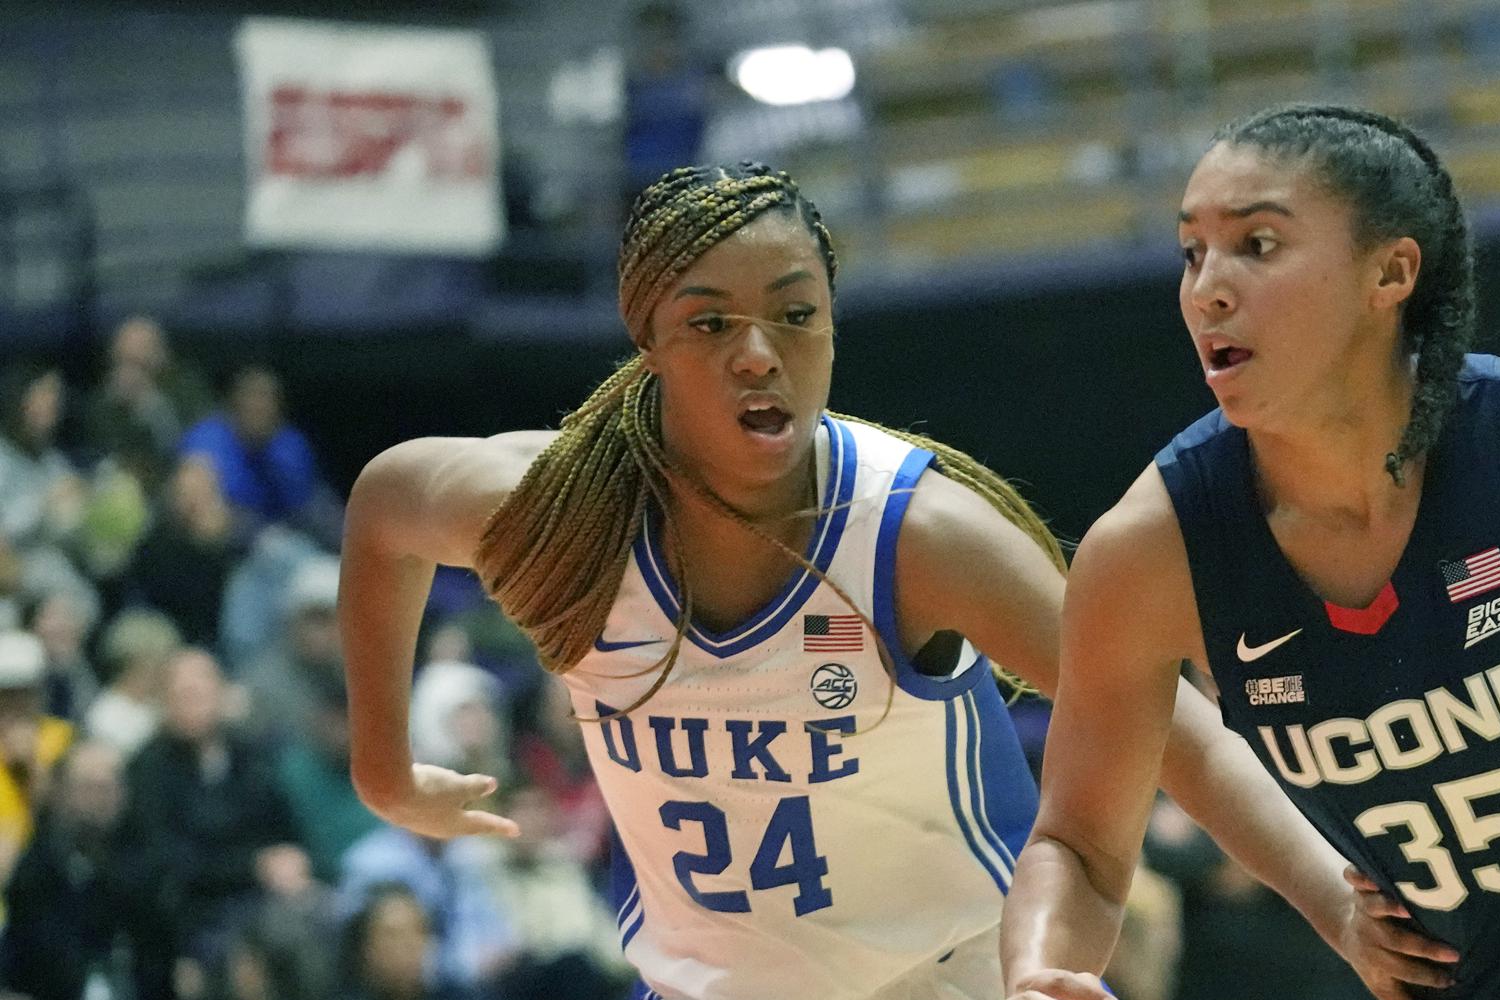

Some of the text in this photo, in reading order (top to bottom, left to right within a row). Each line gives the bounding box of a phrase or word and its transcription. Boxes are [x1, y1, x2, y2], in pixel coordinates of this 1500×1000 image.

[816, 678, 856, 692] ACC
[1249, 690, 1305, 706] CHANGE
[595, 699, 860, 784] DUKE
[658, 795, 834, 918] 24
